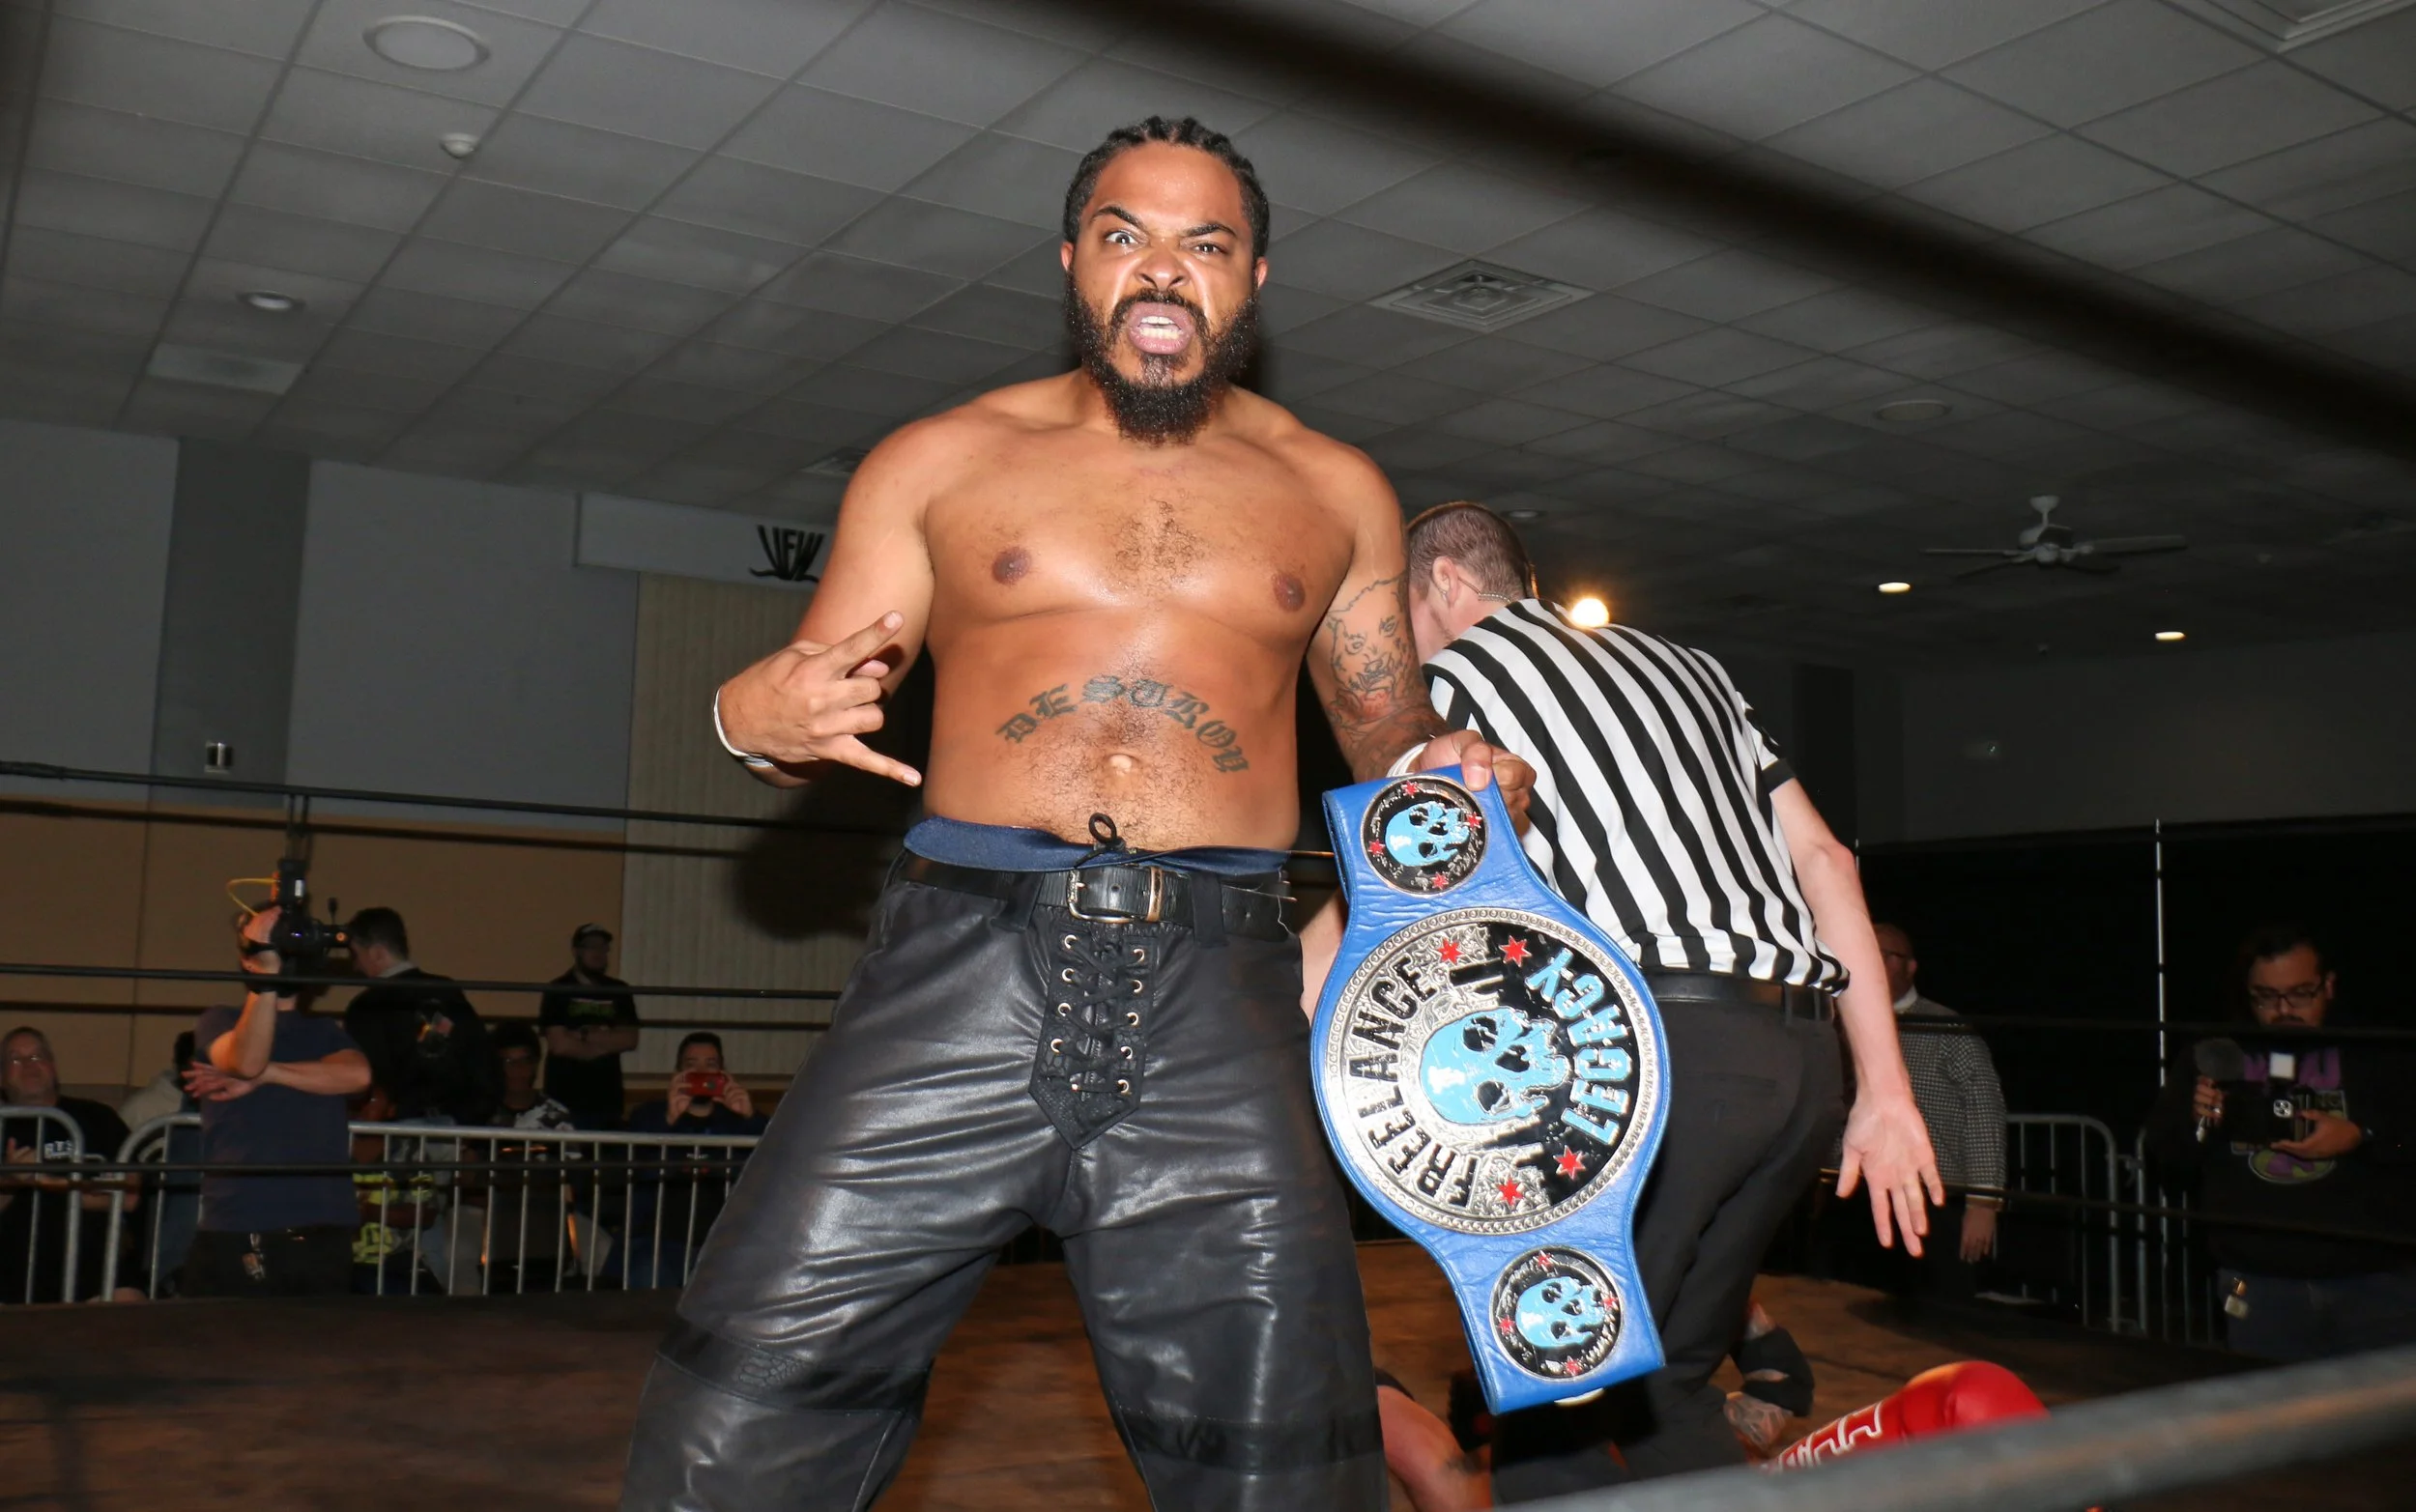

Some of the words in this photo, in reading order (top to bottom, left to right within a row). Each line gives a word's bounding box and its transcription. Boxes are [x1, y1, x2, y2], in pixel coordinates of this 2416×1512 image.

[995, 674, 1250, 773] DESTROY
[1349, 955, 1478, 1210] FREELANCE
[1525, 947, 1633, 1146] LEGACY
